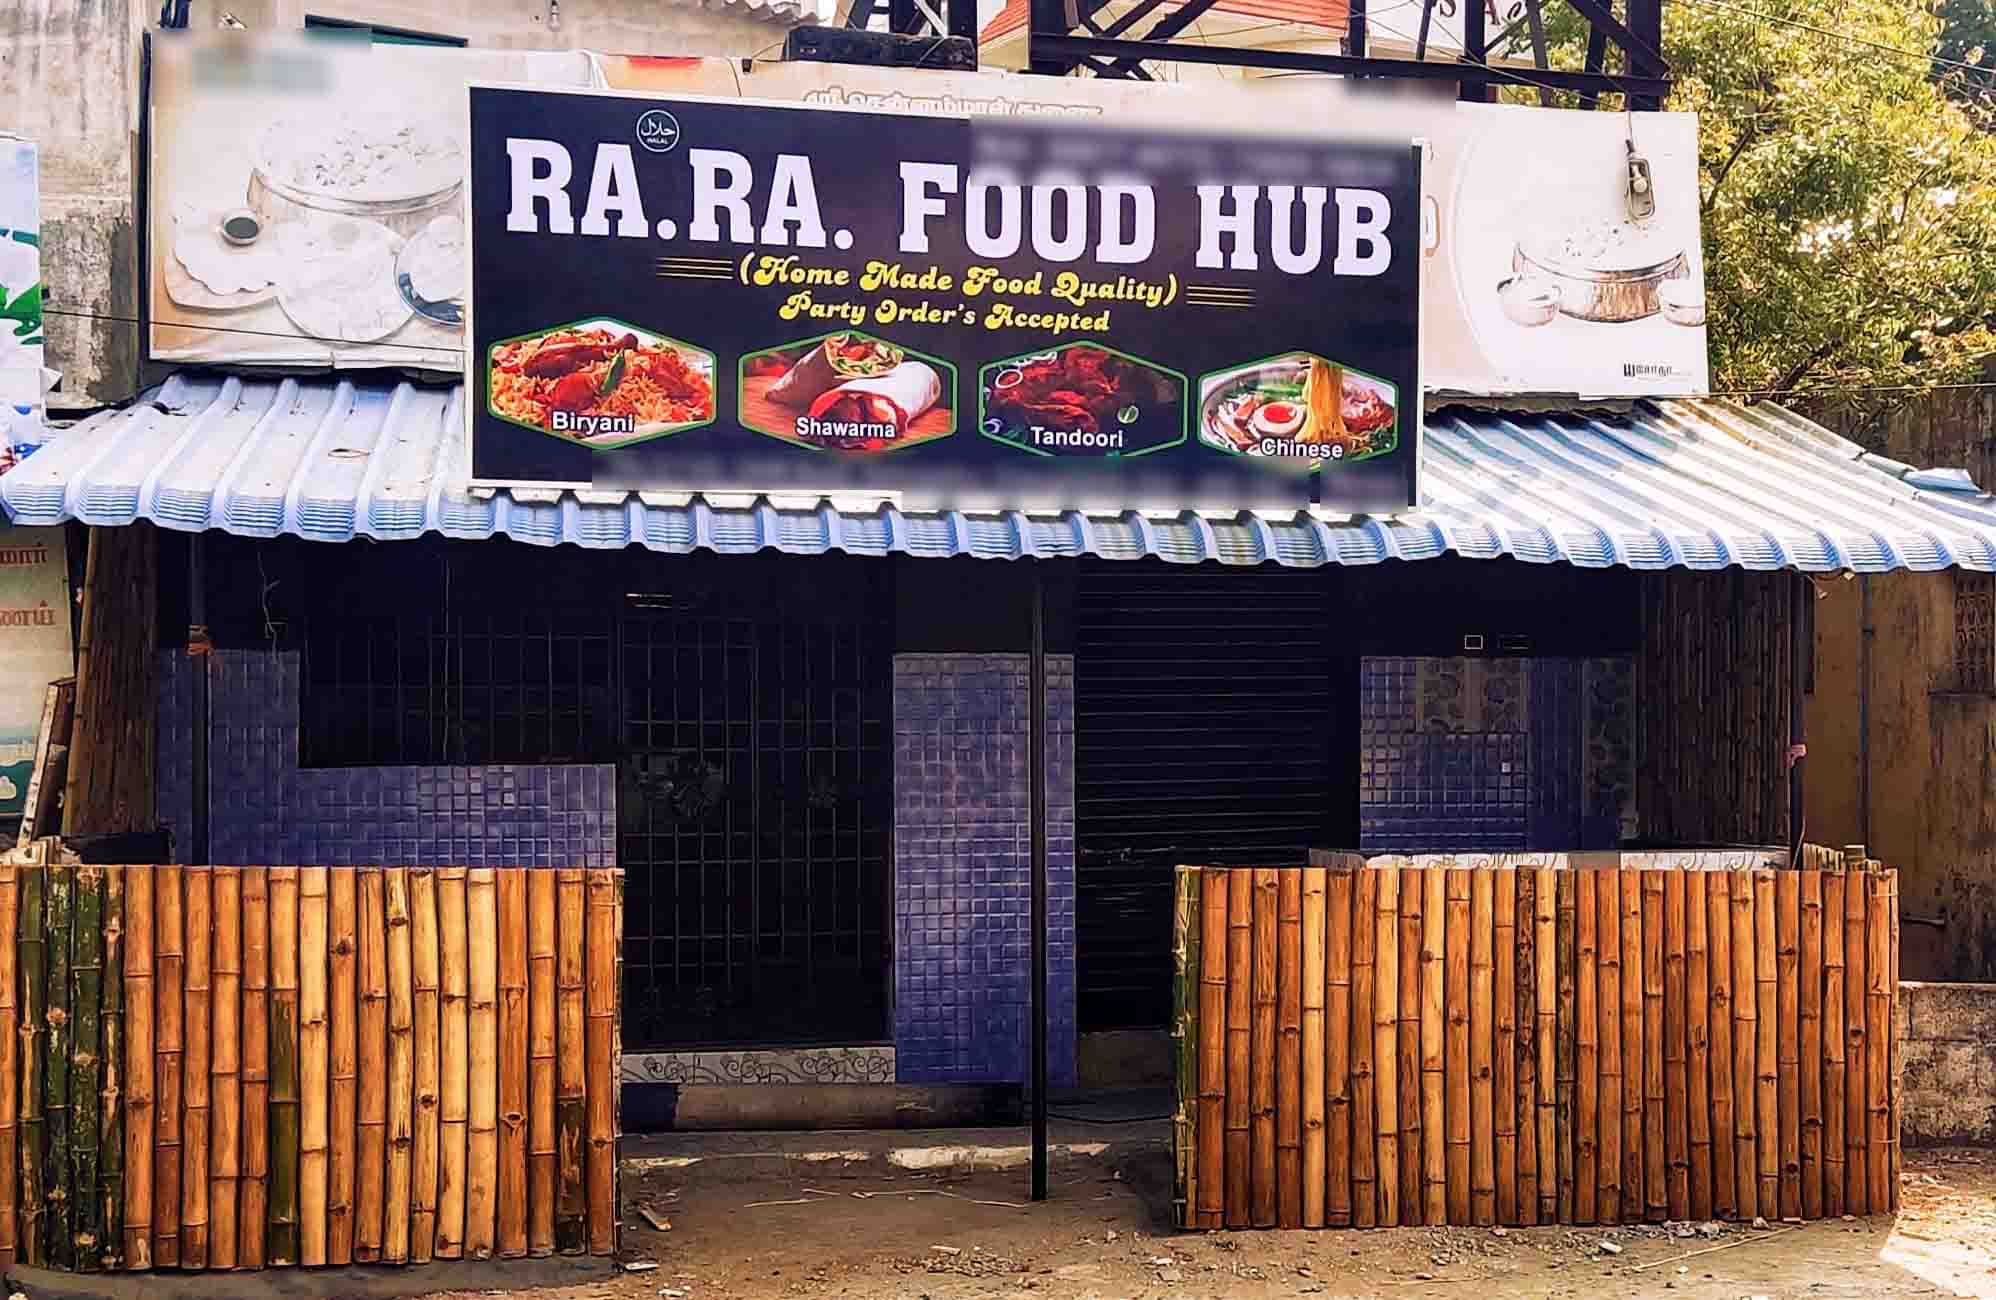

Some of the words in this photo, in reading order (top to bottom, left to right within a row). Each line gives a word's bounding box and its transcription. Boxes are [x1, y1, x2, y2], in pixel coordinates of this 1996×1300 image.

[899, 161, 1156, 264] FOOD
[1196, 184, 1393, 276] HUB
[740, 252, 850, 286] (Home
[859, 261, 953, 291] Made
[962, 266, 1042, 296] Food
[1051, 271, 1178, 307] Quality)
[779, 290, 866, 325] Party
[875, 299, 976, 325] Order's
[984, 303, 1110, 334] Accepted
[552, 411, 635, 434] Biryani
[796, 416, 896, 438] Shawarma
[1031, 426, 1124, 448] Tandoori
[1261, 438, 1344, 459] Chinese
